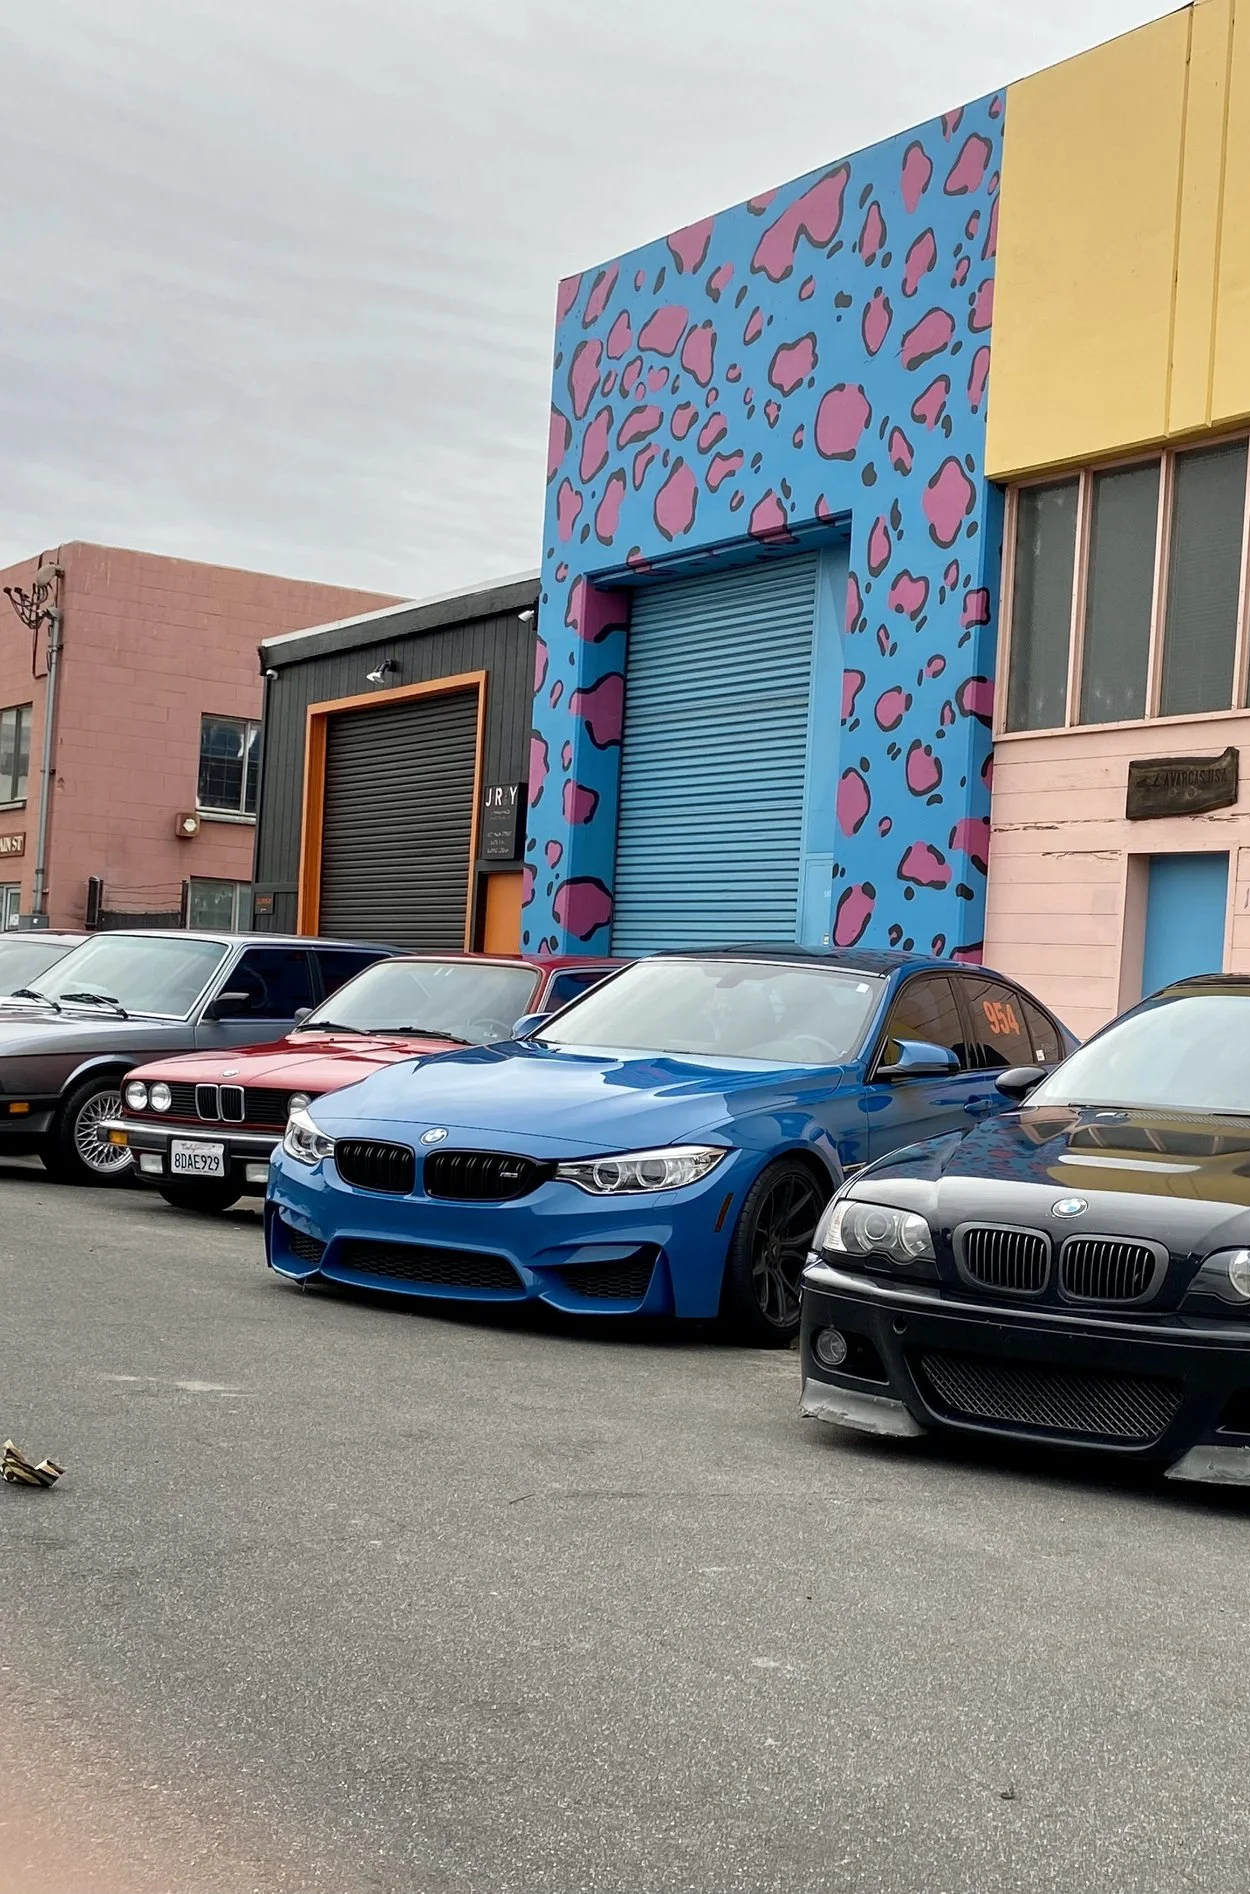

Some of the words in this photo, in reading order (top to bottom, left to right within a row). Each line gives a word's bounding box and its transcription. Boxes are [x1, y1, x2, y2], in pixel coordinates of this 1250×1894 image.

[1207, 767, 1228, 784] USA
[983, 1001, 1020, 1035] 954
[174, 1153, 220, 1171] 8DAE929
